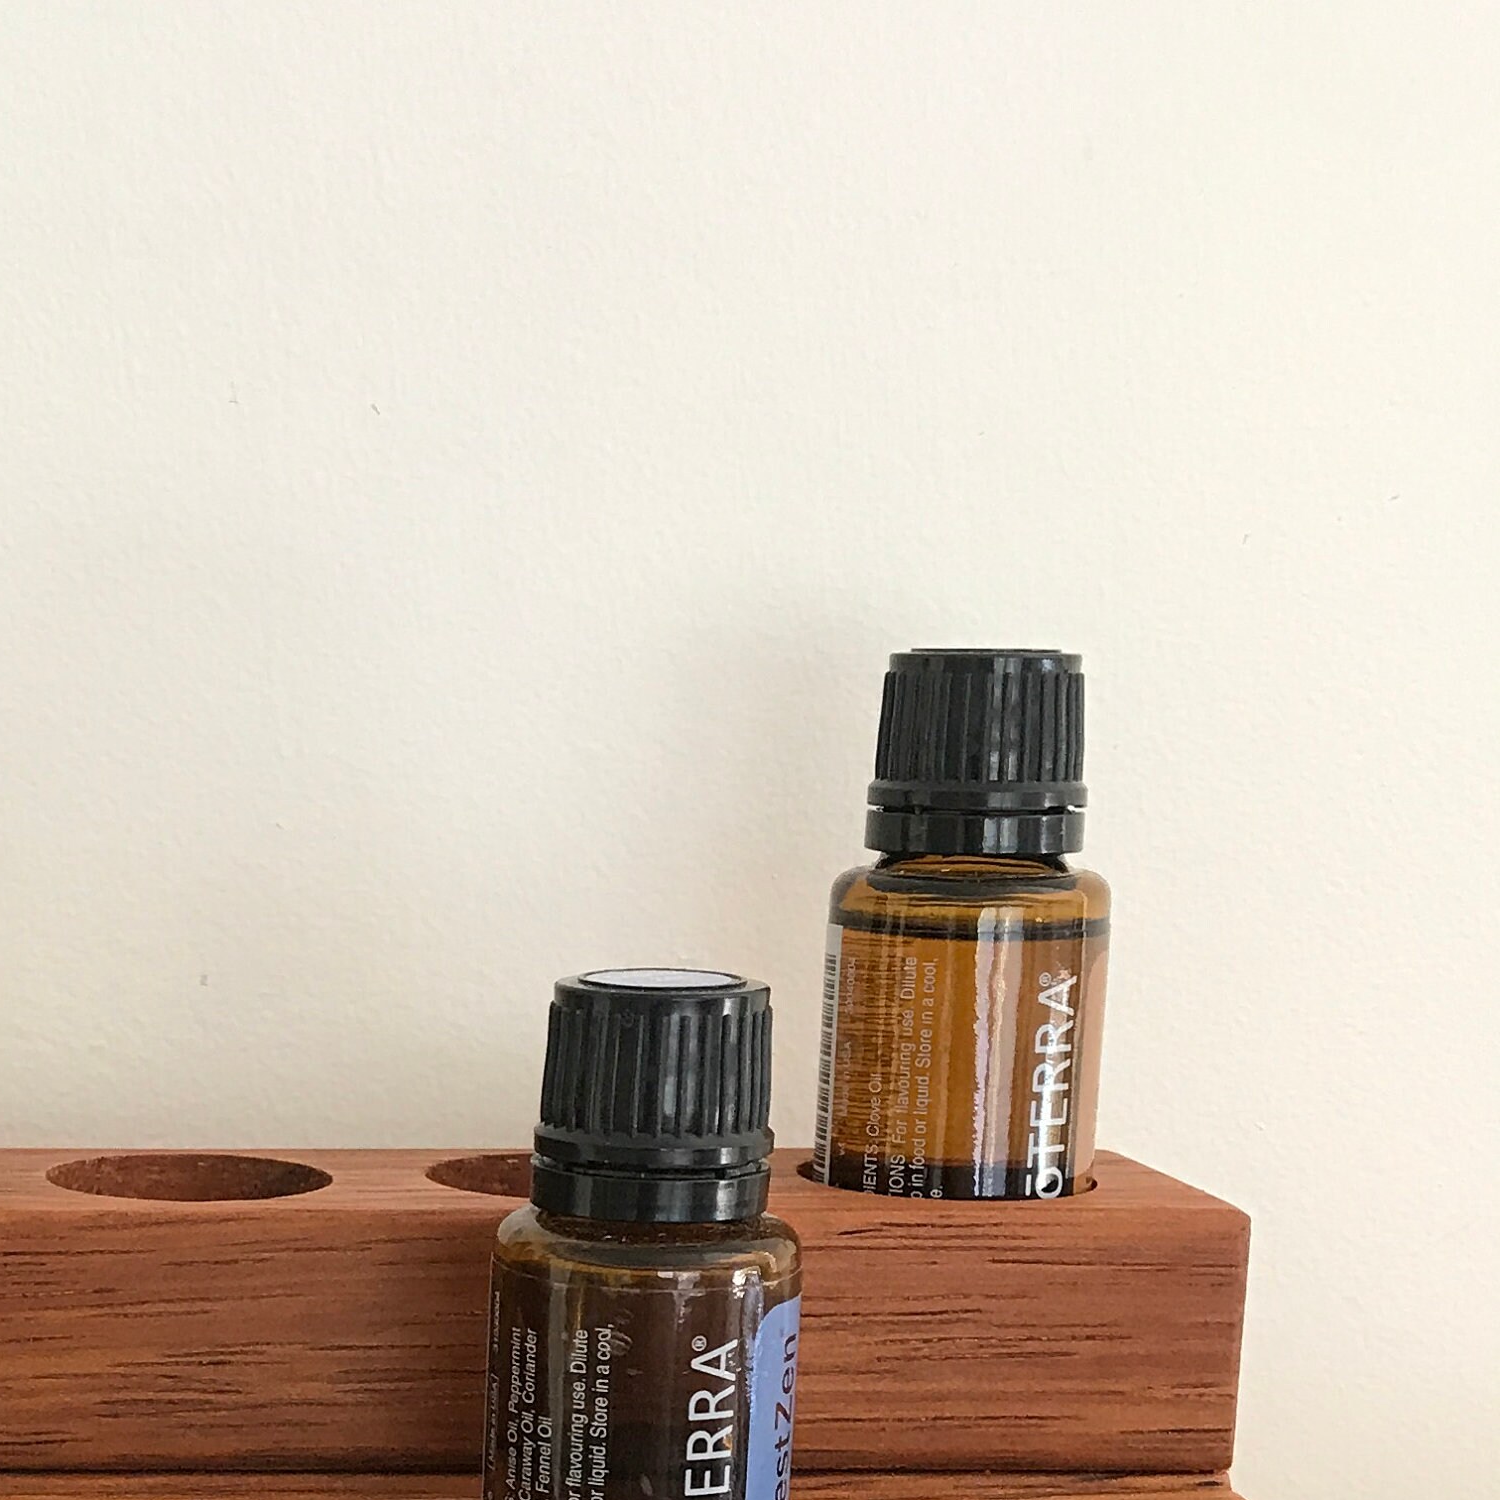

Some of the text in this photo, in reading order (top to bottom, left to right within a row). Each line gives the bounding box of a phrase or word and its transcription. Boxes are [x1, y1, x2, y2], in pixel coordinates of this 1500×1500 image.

[900, 956, 918, 1000] Dilute
[920, 1010, 934, 1025] in
[923, 997, 935, 1008] a
[915, 1029, 933, 1069] Store
[893, 1042, 916, 1114] flavouring
[913, 1072, 931, 1115] liquid.
[866, 1097, 881, 1138] Clove
[891, 1121, 908, 1144] For
[914, 1119, 927, 1134] or
[910, 1138, 926, 1170] food
[908, 1173, 924, 1187] in
[569, 1329, 589, 1374] Dilute
[594, 1322, 615, 1362] cool,
[508, 1326, 523, 1415] Peppermint
[522, 1327, 538, 1405] Coriander
[590, 1377, 611, 1394] in
[595, 1365, 611, 1376] a
[570, 1378, 587, 1411] use.
[521, 1409, 537, 1435] Oil,
[536, 1415, 553, 1439] Oil
[589, 1397, 609, 1440] Store
[504, 1447, 518, 1490] Anise
[534, 1441, 553, 1495] Fennel
[565, 1414, 589, 1488] flavouring
[586, 1442, 610, 1487] liquid.
